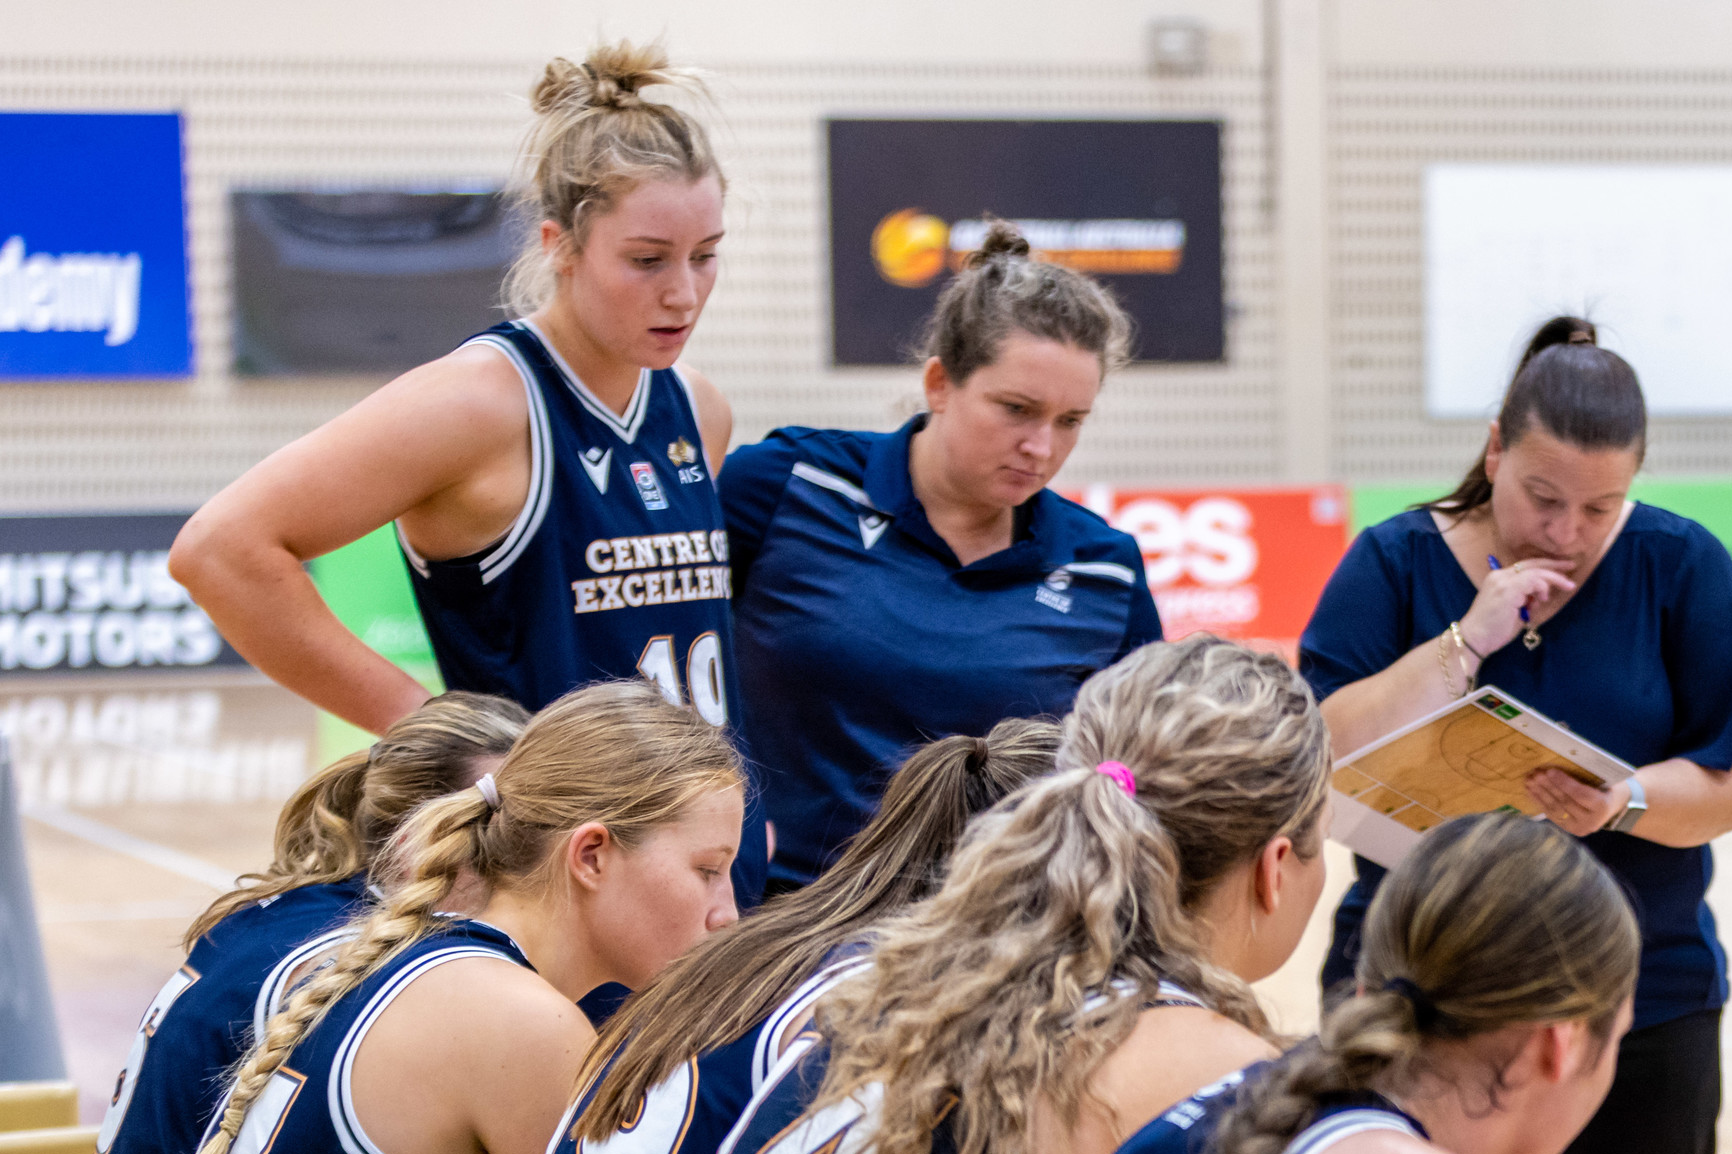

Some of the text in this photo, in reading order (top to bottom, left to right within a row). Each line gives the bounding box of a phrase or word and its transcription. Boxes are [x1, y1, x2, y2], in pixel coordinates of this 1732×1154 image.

[678, 465, 705, 485] AIS
[585, 531, 712, 573] CENTRE
[0, 550, 195, 609] ITSUB
[637, 630, 727, 728] 10
